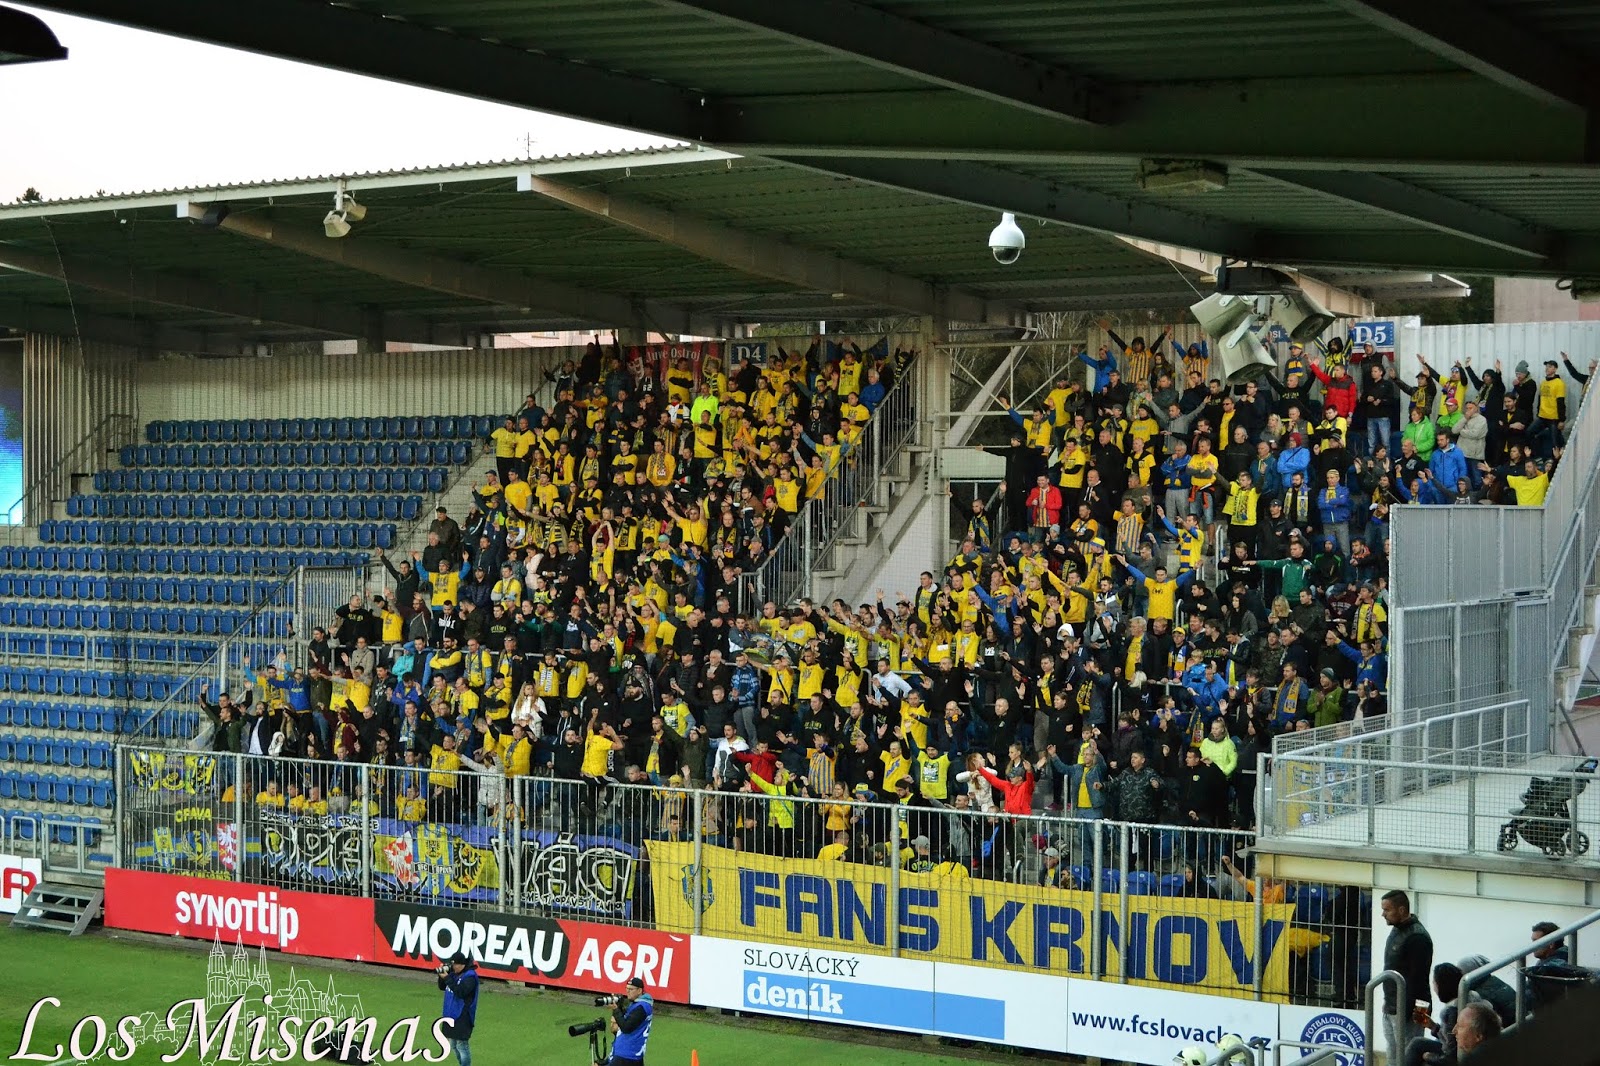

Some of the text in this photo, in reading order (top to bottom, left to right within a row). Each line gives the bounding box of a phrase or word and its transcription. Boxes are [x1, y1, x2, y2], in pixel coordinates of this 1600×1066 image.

[1355, 326, 1386, 345] D5
[670, 347, 701, 361] Ostroj
[737, 345, 762, 364] D4
[175, 806, 212, 823] OPAVA
[738, 866, 1287, 985] FANS KRNOV
[391, 913, 564, 974] MOREAU
[744, 948, 860, 978] SLOVÁCKÝ
[746, 976, 843, 1015] deník
[1072, 1011, 1271, 1051] www.fcslovackcz
[1305, 1016, 1363, 1043] FOTBALOVÝ KLUB
[1321, 1032, 1348, 1043] 1.FC
